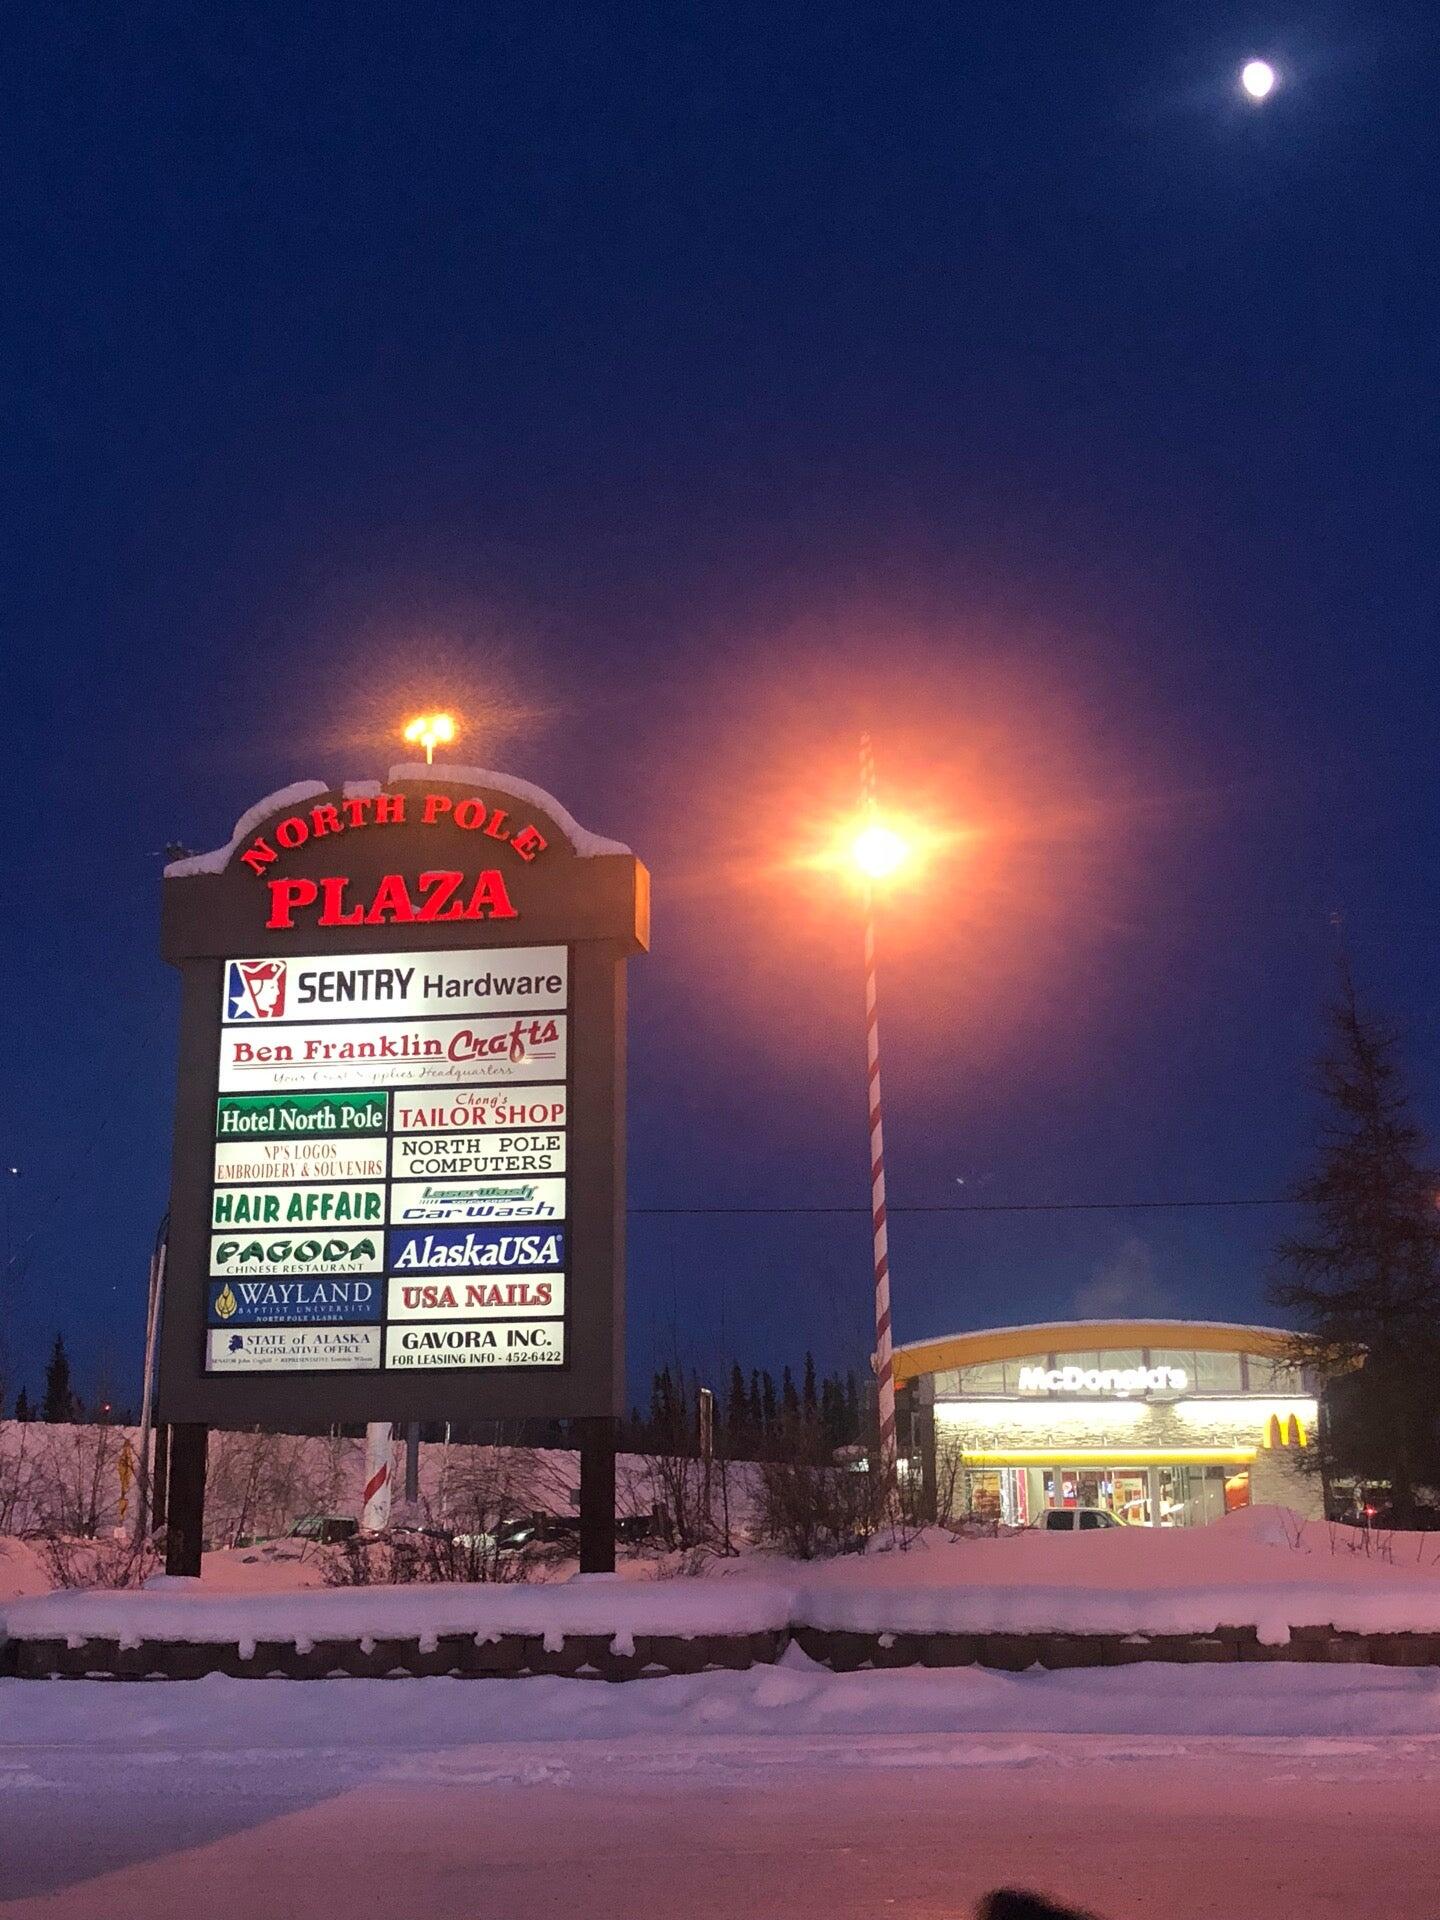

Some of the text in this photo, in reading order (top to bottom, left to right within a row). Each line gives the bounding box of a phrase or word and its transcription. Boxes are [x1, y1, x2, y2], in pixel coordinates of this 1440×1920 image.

[240, 793, 548, 876] NORTH POLE
[265, 869, 518, 929] PLAZA
[298, 967, 563, 1004] SENTRY Hardware
[232, 1019, 560, 1064] Ben Franklin Crafts
[418, 1065, 514, 1082] Headquarters
[455, 1092, 508, 1109] Chong's
[220, 1104, 383, 1133] Hotel North Pole
[399, 1103, 565, 1129] TAILOR SHOP
[294, 1143, 338, 1160] LOGOS
[401, 1135, 561, 1156] NORTH POLE
[216, 1159, 383, 1180] EMBROIDERY & SOUVENIRS
[409, 1154, 552, 1175] COMPUTERS
[214, 1190, 382, 1224] HAIR AFFAIR
[215, 1237, 376, 1265] PAGODA
[226, 1263, 365, 1275] CHINESE RESTAURANT
[237, 1282, 373, 1305] WAYLAND
[402, 1282, 553, 1309] USA NAILS
[238, 1304, 372, 1315] BAPTIST UNIVERSITY
[246, 1333, 371, 1345] STATE of ALASKA
[253, 1345, 361, 1355] LEGISLATIVE OFFICE
[401, 1328, 553, 1350] GAVORA INC.
[392, 1354, 414, 1366] FOR
[469, 1352, 495, 1364] INFO
[505, 1351, 562, 1363] 452-6422
[1018, 1366, 1188, 1390] McDonald's
